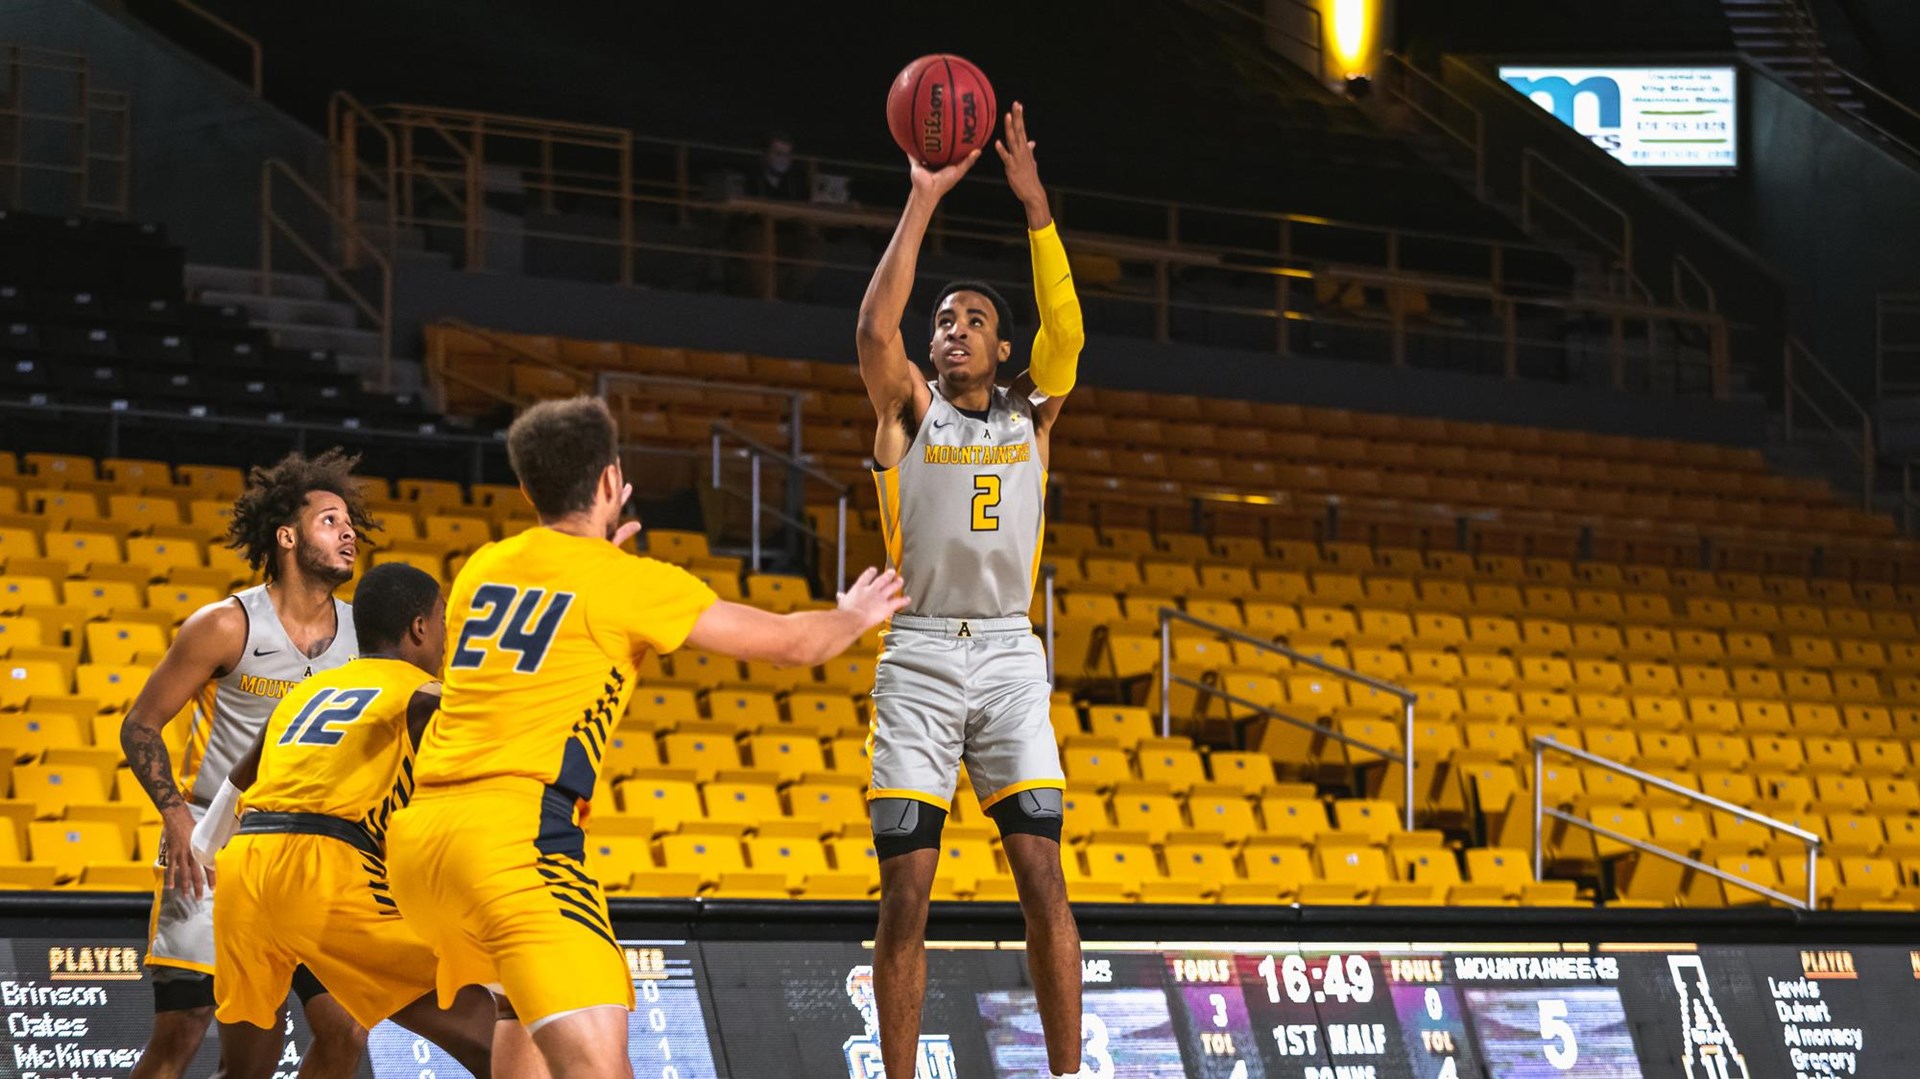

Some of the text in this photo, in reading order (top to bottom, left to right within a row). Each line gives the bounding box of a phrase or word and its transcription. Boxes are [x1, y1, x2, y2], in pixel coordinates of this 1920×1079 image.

[923, 83, 943, 153] Wilson
[961, 91, 977, 144] NCAA
[970, 474, 1002, 532] 2
[449, 583, 576, 675] 24
[957, 621, 972, 637] A
[277, 686, 382, 748] 12
[50, 947, 138, 972] PLAYER
[1173, 959, 1230, 982] FOULS
[1390, 959, 1443, 982] FOULS
[1453, 957, 1619, 980] MOUNTAINEERS
[1800, 950, 1855, 972] PLAYER
[642, 979, 660, 1003] 0
[1257, 954, 1375, 1003] 16:49
[1767, 976, 1821, 999] Lewis
[1, 981, 108, 1006] Brinson
[649, 1007, 667, 1032] 0
[1209, 993, 1229, 1027] 3
[7, 1012, 89, 1037] Oates
[1537, 999, 1578, 1070] 5
[658, 1036, 672, 1061] 1
[1200, 1032, 1237, 1056] TOL
[1272, 1023, 1387, 1056] 1ST HALF
[1420, 1030, 1456, 1053] TOL
[1789, 1047, 1857, 1075] Gregory
